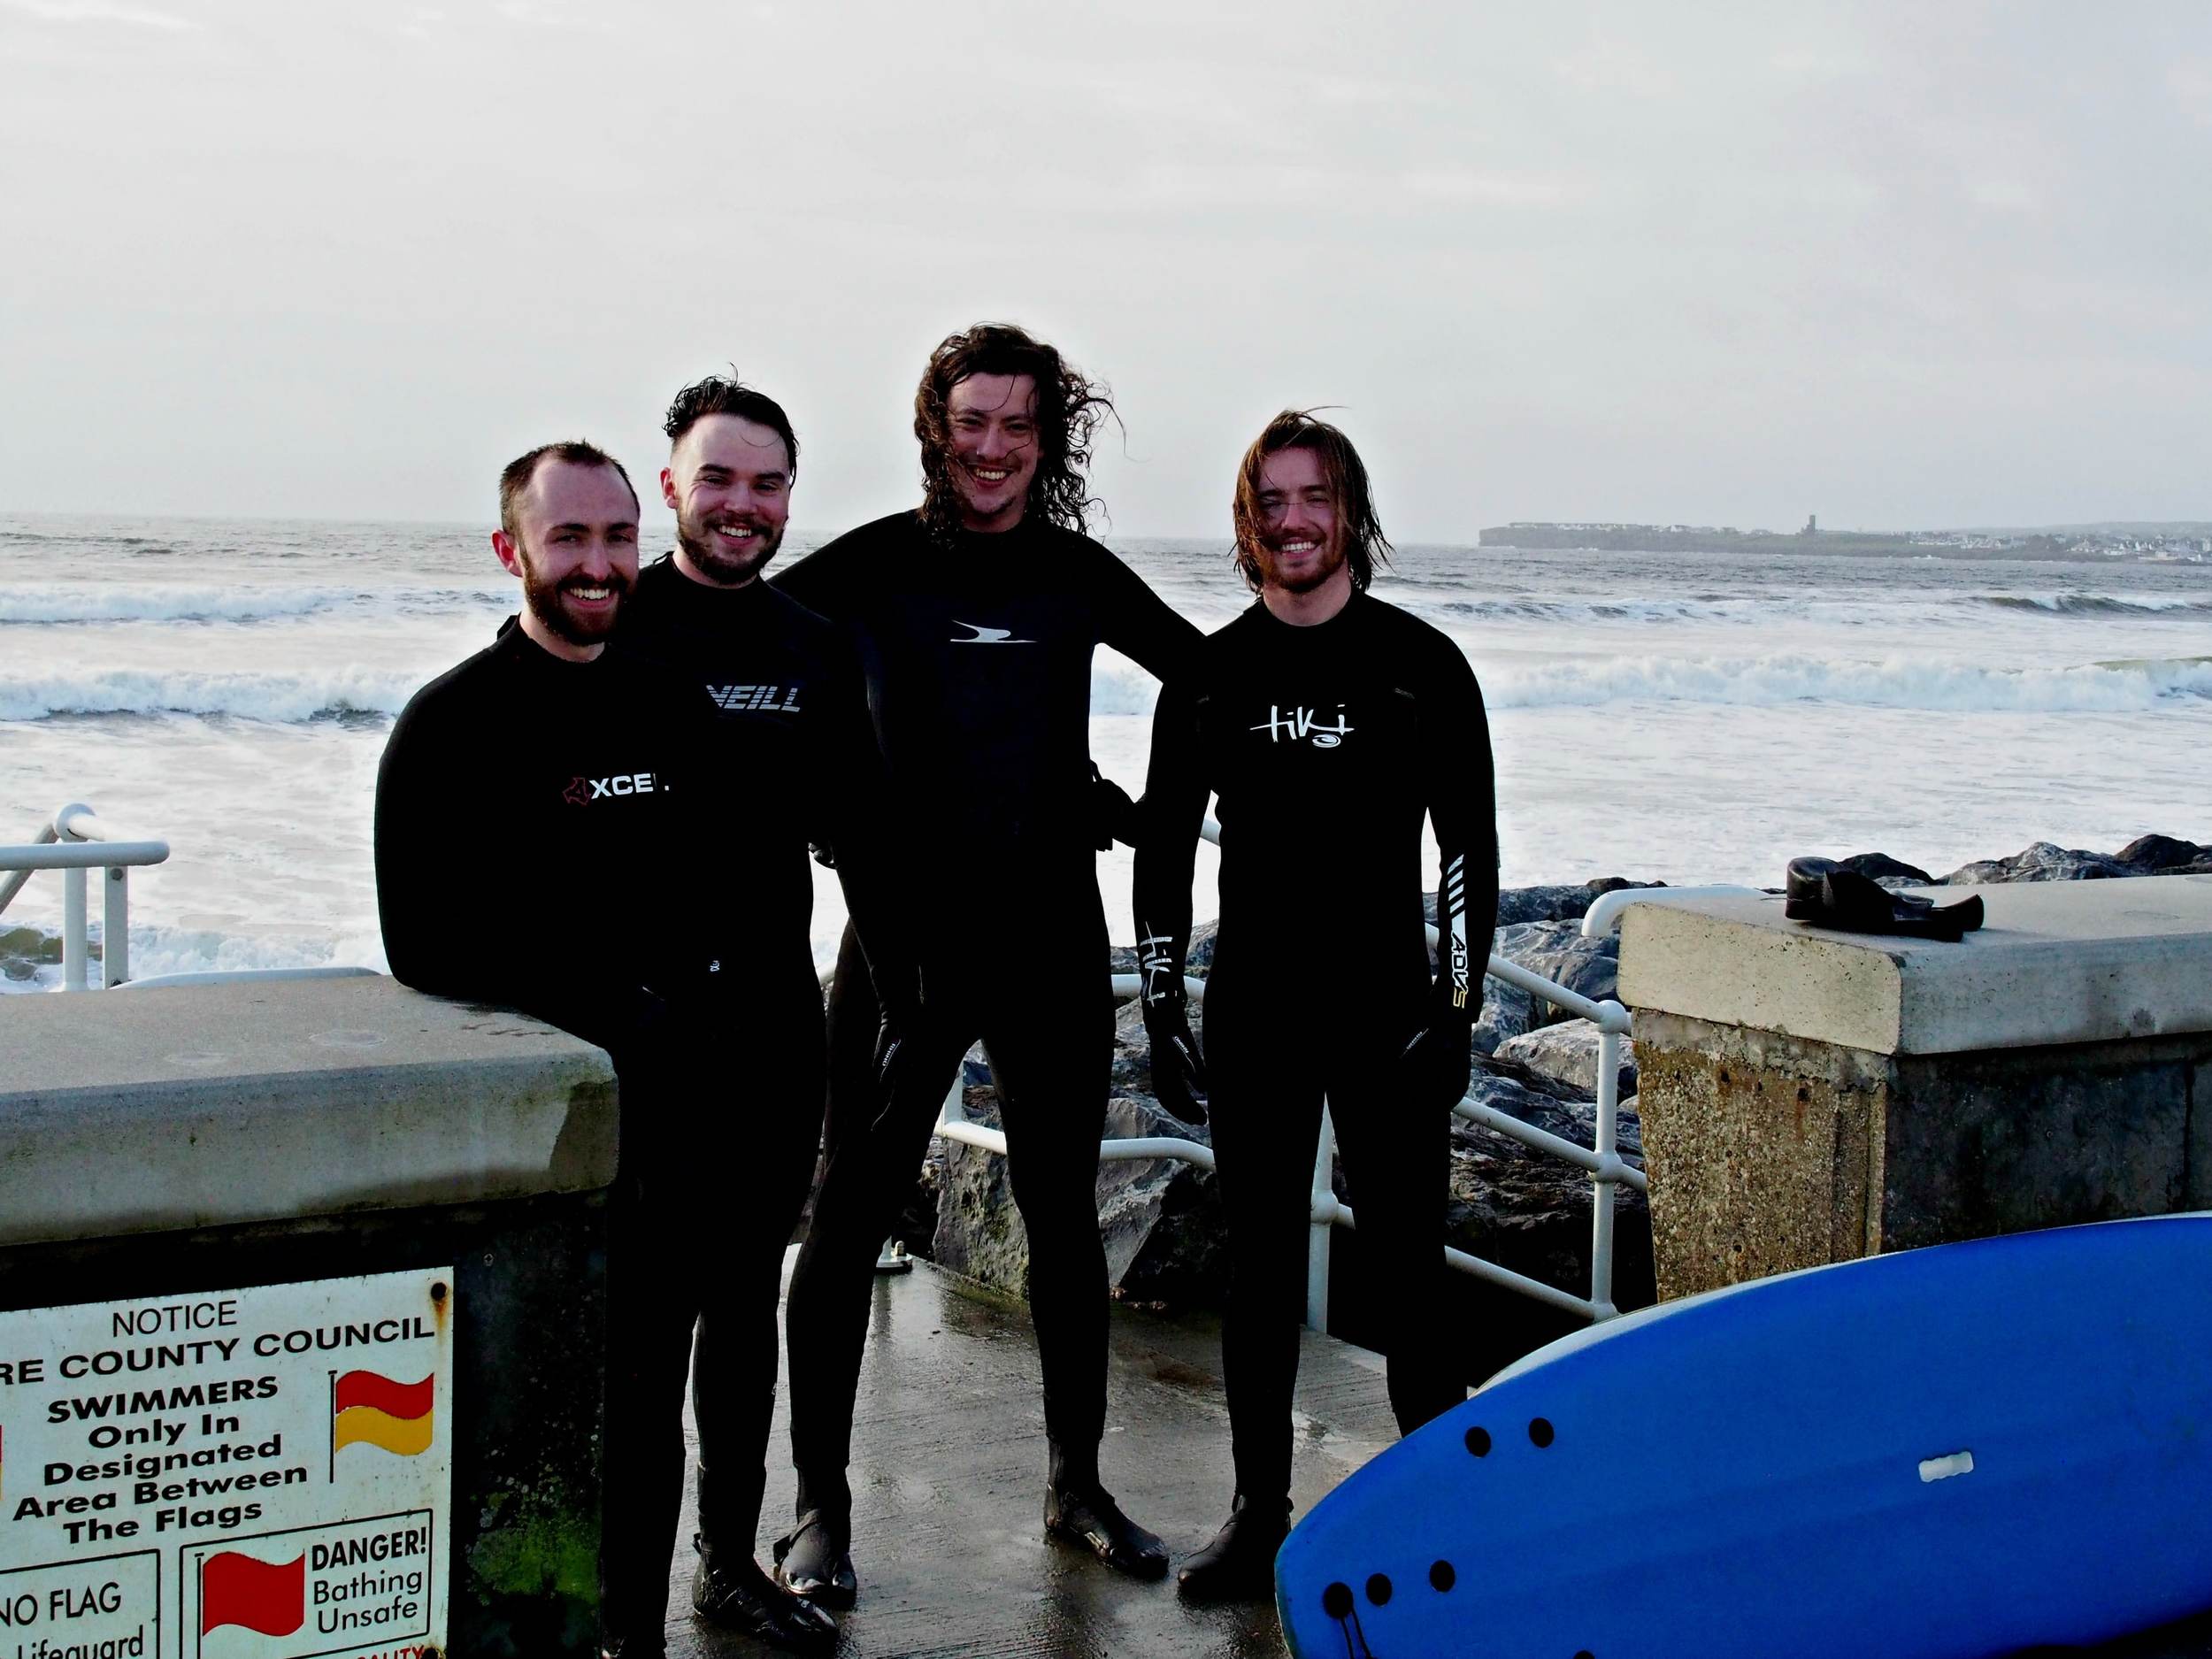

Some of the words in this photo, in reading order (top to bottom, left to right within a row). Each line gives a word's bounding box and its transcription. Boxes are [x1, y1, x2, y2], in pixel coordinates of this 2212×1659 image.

[589, 772, 670, 800] XCE
[112, 1300, 238, 1338] NOTICE
[59, 1337, 241, 1379] COUNTY
[253, 1317, 435, 1357] COUNCIL
[47, 1376, 279, 1424] SWIMMERS
[88, 1418, 187, 1449] Only
[202, 1413, 240, 1436] In
[43, 1433, 281, 1486] Designated
[12, 1493, 117, 1522] Area
[134, 1467, 307, 1505] Between
[62, 1520, 140, 1545] The
[156, 1502, 262, 1532] Flags
[311, 1526, 426, 1571] DANGER!
[0, 1594, 38, 1628] NO
[49, 1581, 121, 1622] FLAG
[313, 1570, 422, 1606] Bathing
[318, 1594, 419, 1634] Unsafe
